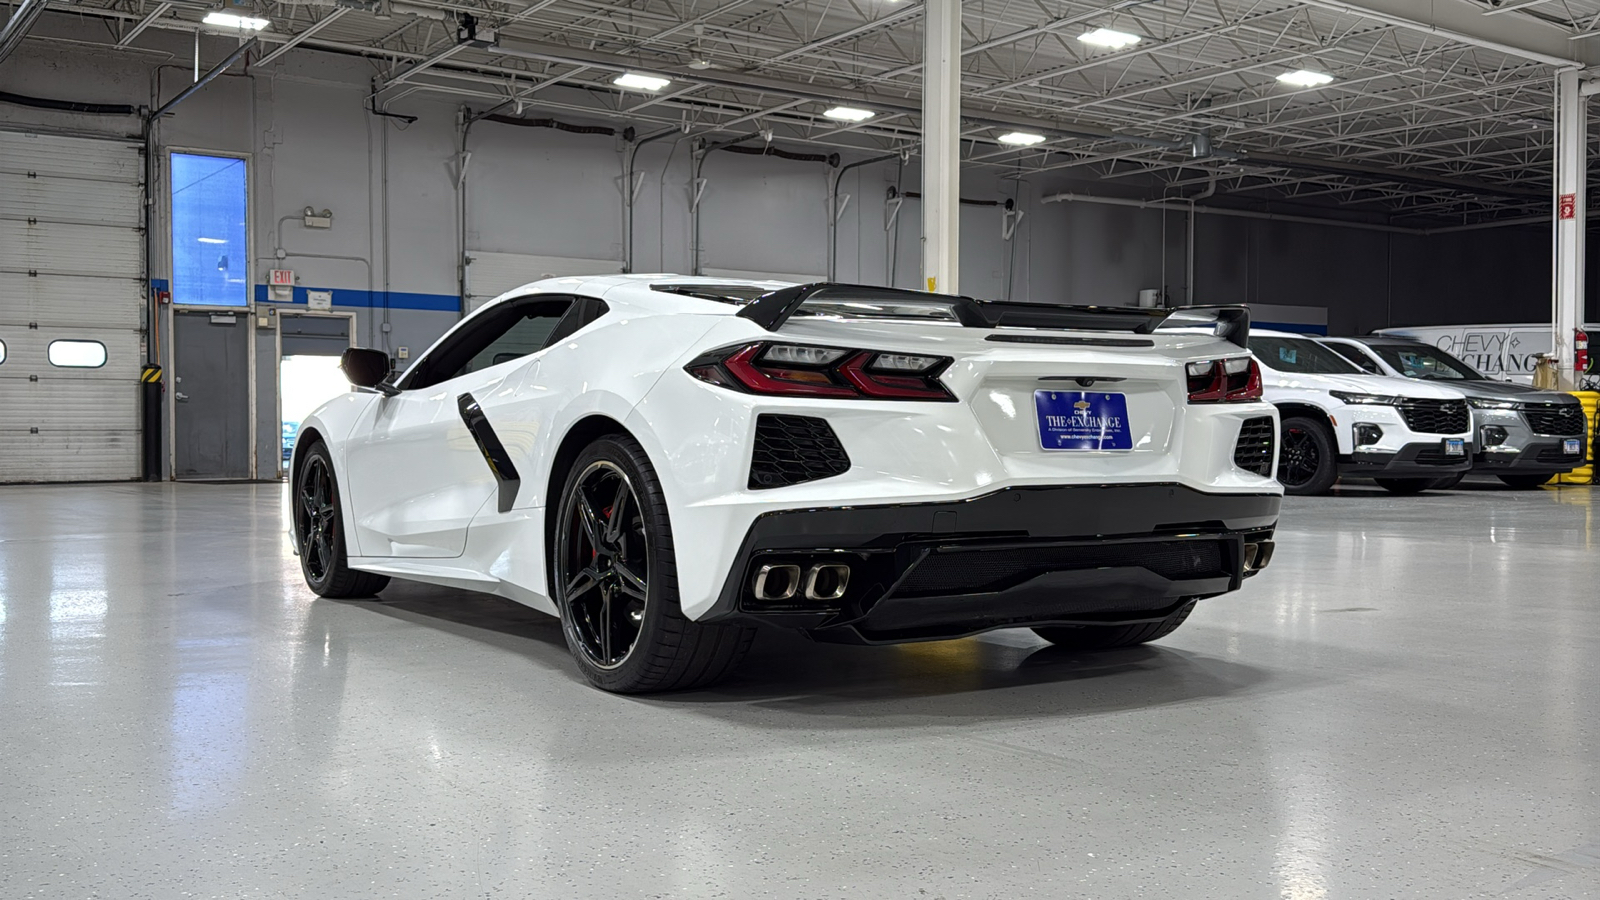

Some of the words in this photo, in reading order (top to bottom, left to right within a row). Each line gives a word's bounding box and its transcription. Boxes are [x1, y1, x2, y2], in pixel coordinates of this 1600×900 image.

[274, 270, 291, 284] EXIT
[1436, 334, 1510, 352] CHEVY
[1046, 416, 1067, 427] THE
[1071, 415, 1121, 428] EXCHANGE
